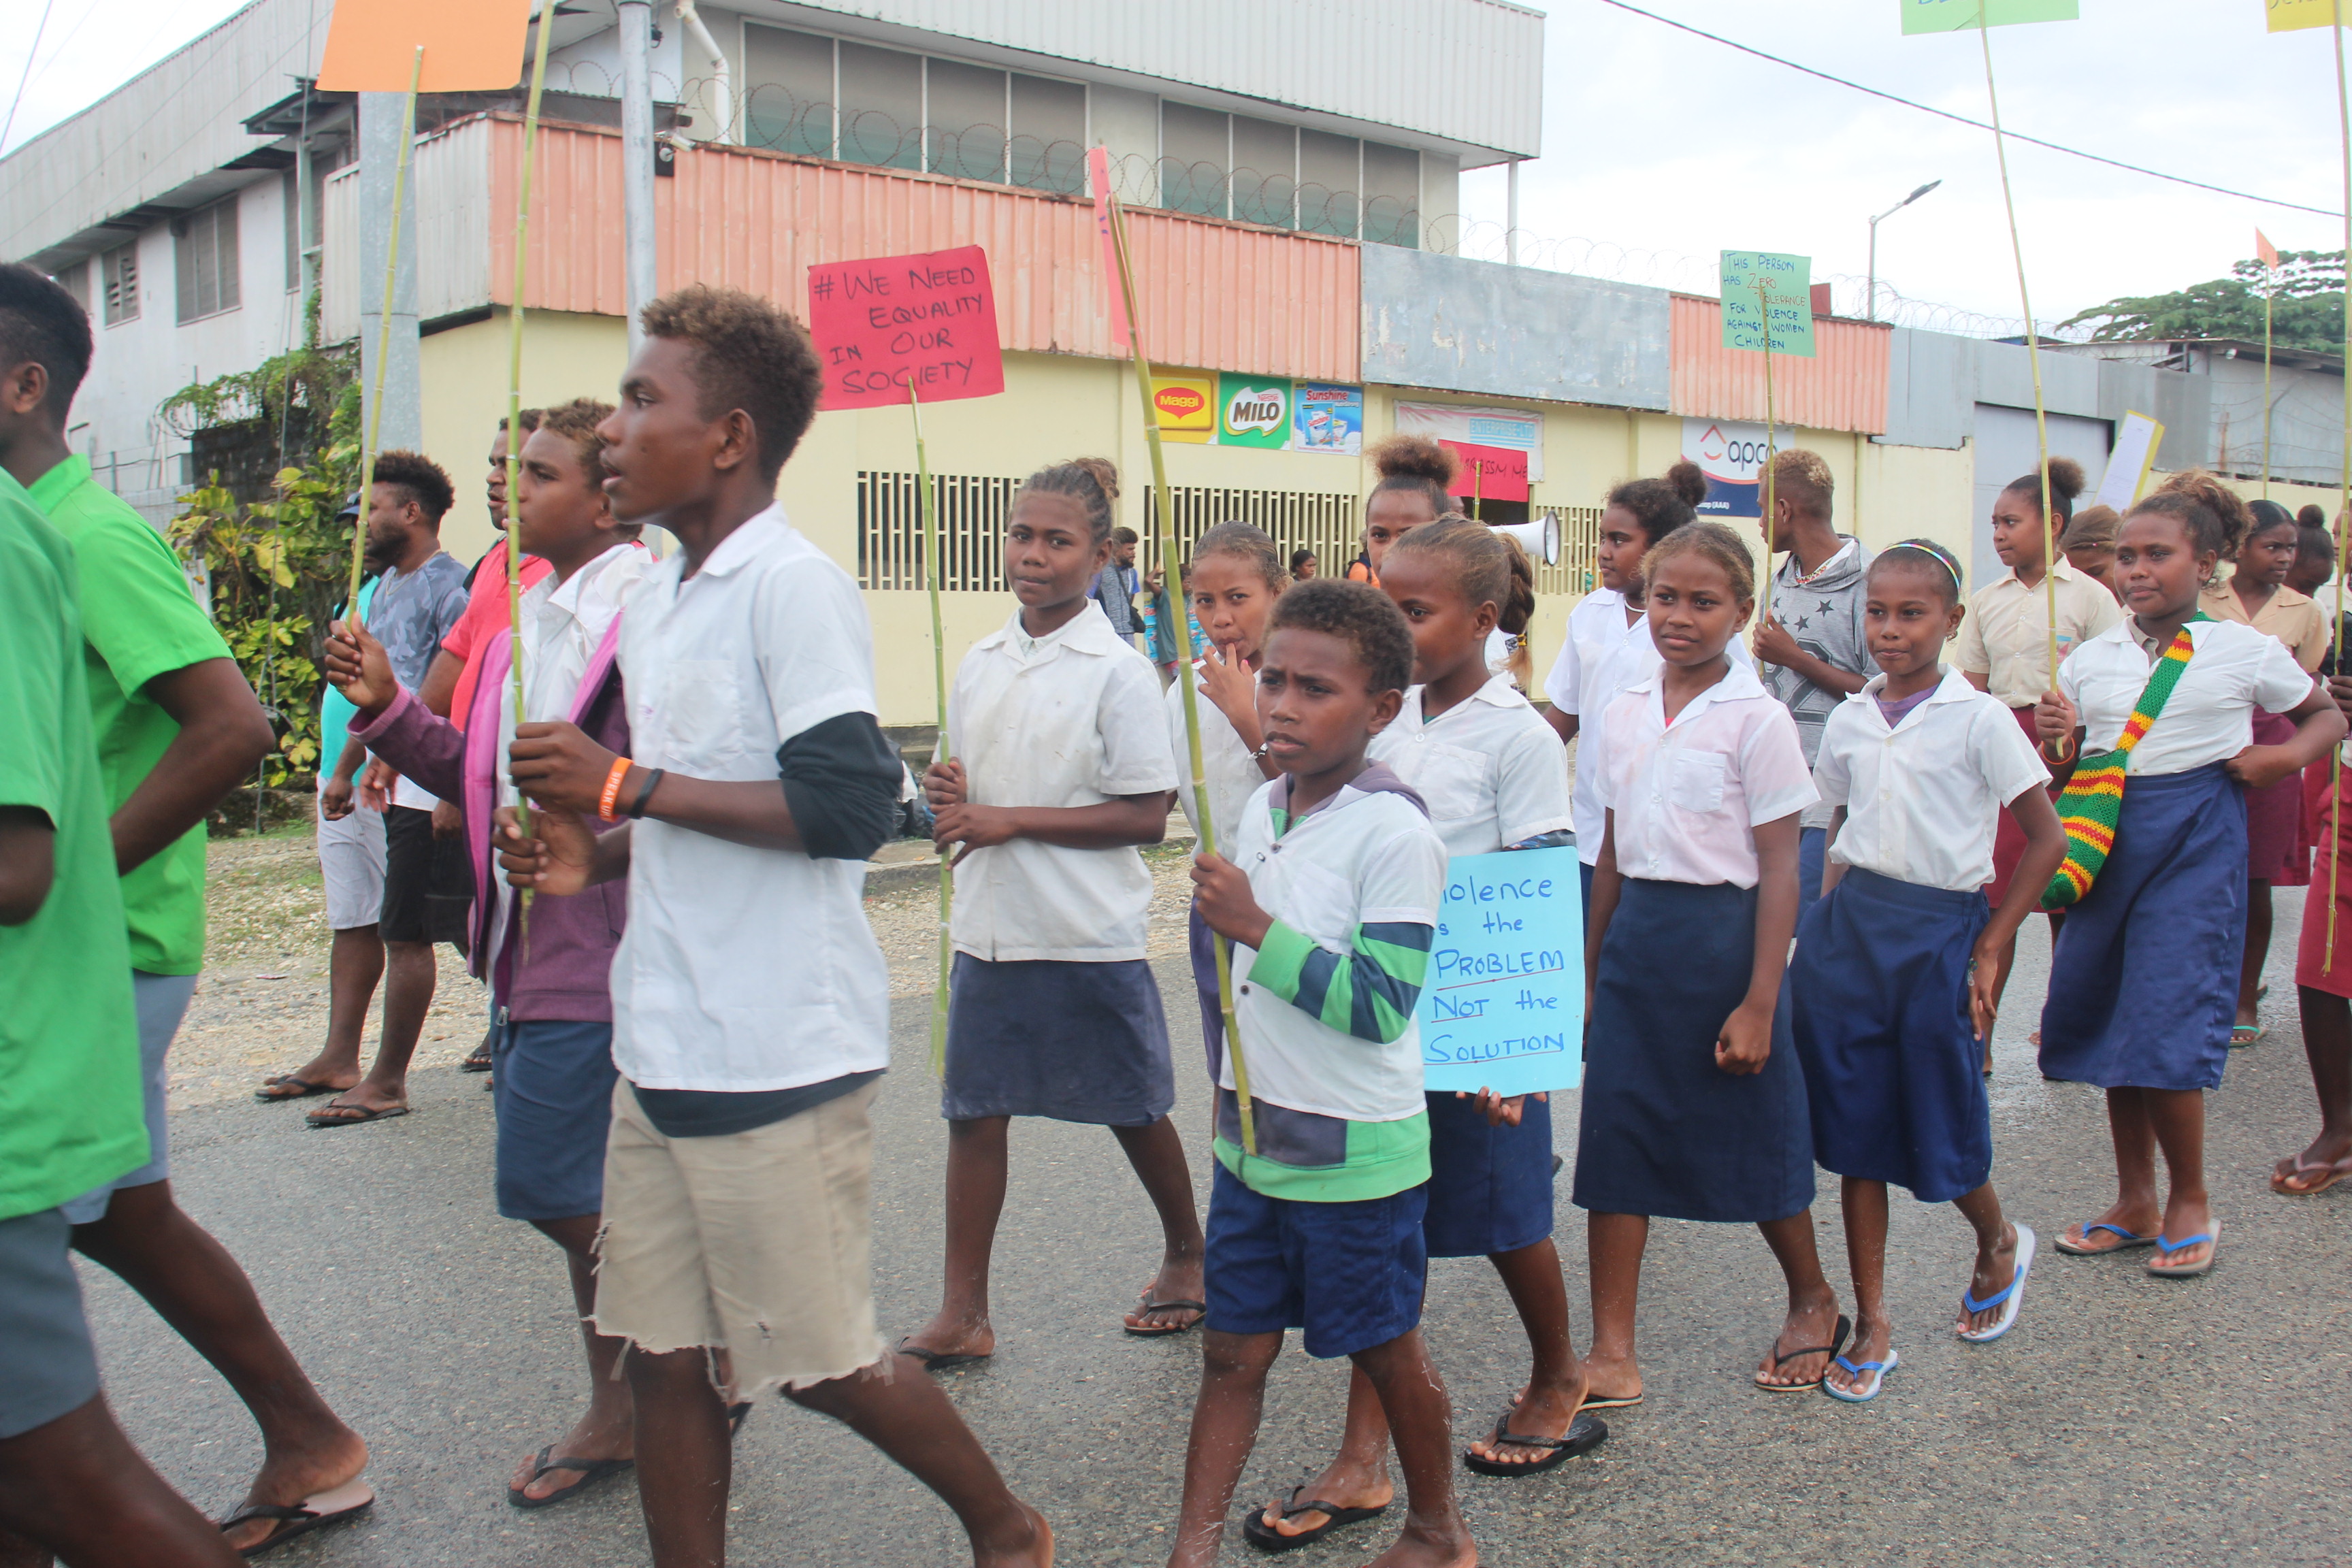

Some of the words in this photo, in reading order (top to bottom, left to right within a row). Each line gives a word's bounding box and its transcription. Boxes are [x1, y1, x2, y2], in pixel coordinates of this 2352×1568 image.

[1758, 255, 1794, 272] PERSON
[844, 270, 890, 299] WE
[909, 267, 975, 290] NEED
[1723, 276, 1741, 286] HAS
[1747, 273, 1776, 289] ZERO
[869, 293, 982, 329] EQUALITY
[1730, 302, 1746, 314] FOR
[1754, 305, 1798, 321] VOLENCE
[1771, 323, 1804, 333] WOMEN
[830, 344, 862, 365] IN
[891, 328, 953, 354] OUR
[843, 357, 973, 393] SOCIETY
[1160, 395, 1199, 408] Maggi
[1306, 389, 1349, 402] Sunshine
[1232, 402, 1280, 423] MILO
[603, 772, 622, 804] SPEAK
[1443, 875, 1552, 904] iolence
[1438, 923, 1450, 936] s
[1483, 911, 1523, 934] the
[1435, 949, 1564, 979] PROBLEM
[1433, 995, 1490, 1019] NOT
[1516, 990, 1558, 1010] the
[1425, 1033, 1564, 1062] SOLUTION
